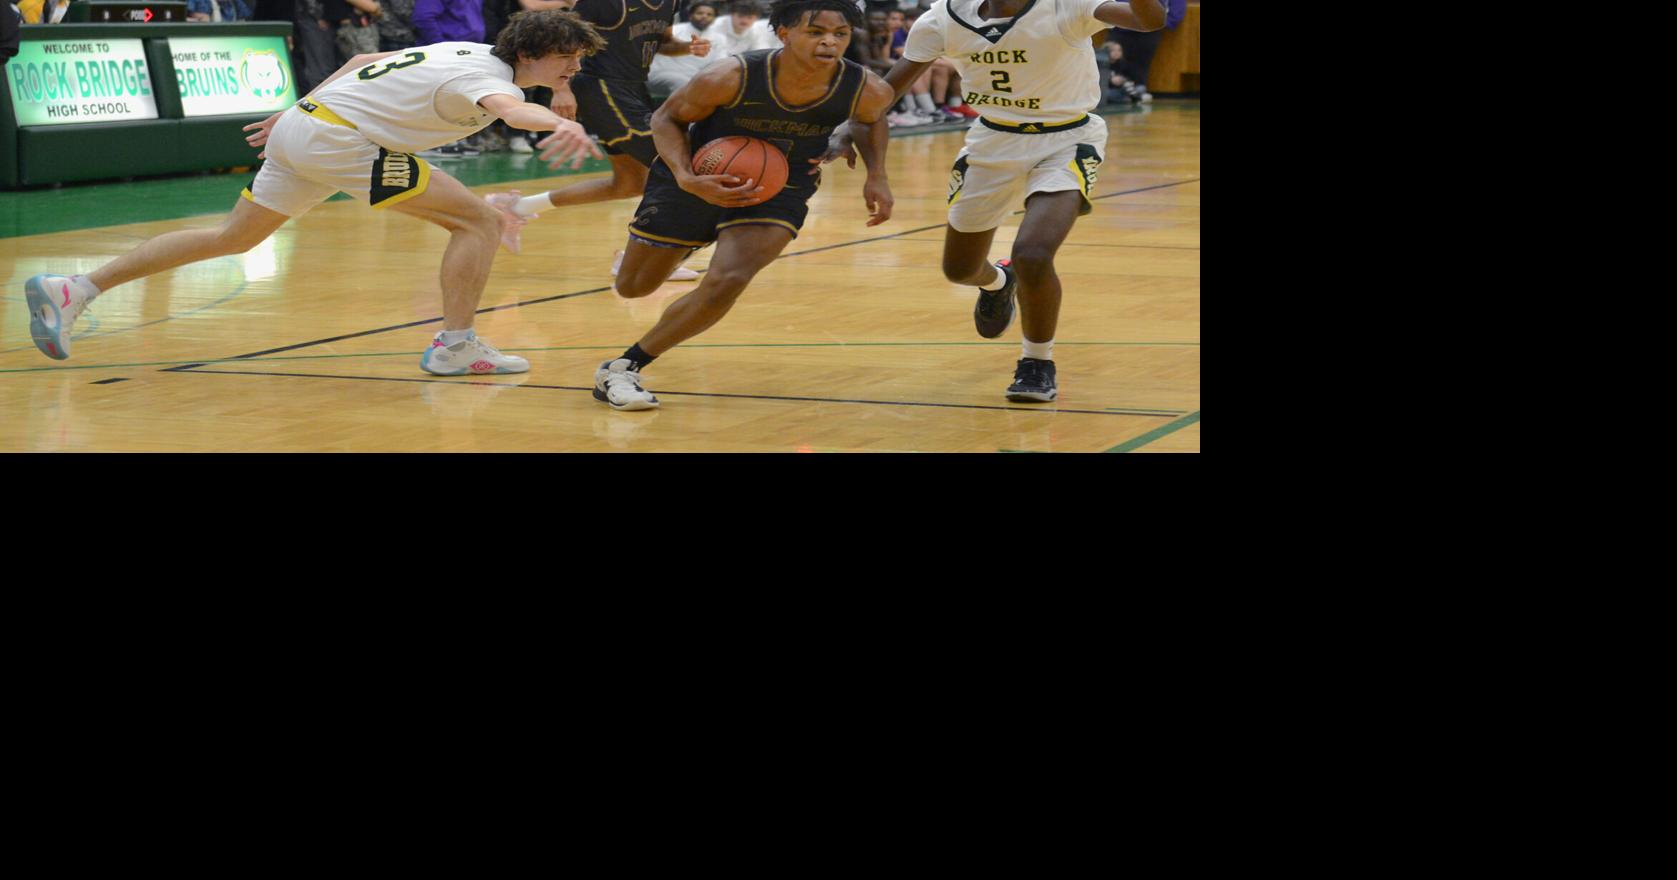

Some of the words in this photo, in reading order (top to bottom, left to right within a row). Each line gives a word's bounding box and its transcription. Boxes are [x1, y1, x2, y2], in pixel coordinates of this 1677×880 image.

[43, 44, 93, 54] WELCOME
[97, 43, 110, 53] TO
[172, 52, 197, 62] HOME
[200, 52, 212, 61] OF
[214, 51, 232, 61] THE
[970, 50, 1028, 64] ROCK
[357, 51, 427, 81] 3
[12, 62, 73, 101] ROCK
[75, 59, 150, 98] BRIDGE
[175, 66, 239, 97] BRUINS
[990, 70, 1013, 93] 2
[966, 92, 1041, 109] BRIDGE
[47, 105, 79, 118] HIGH
[82, 102, 131, 116] SCHOOL
